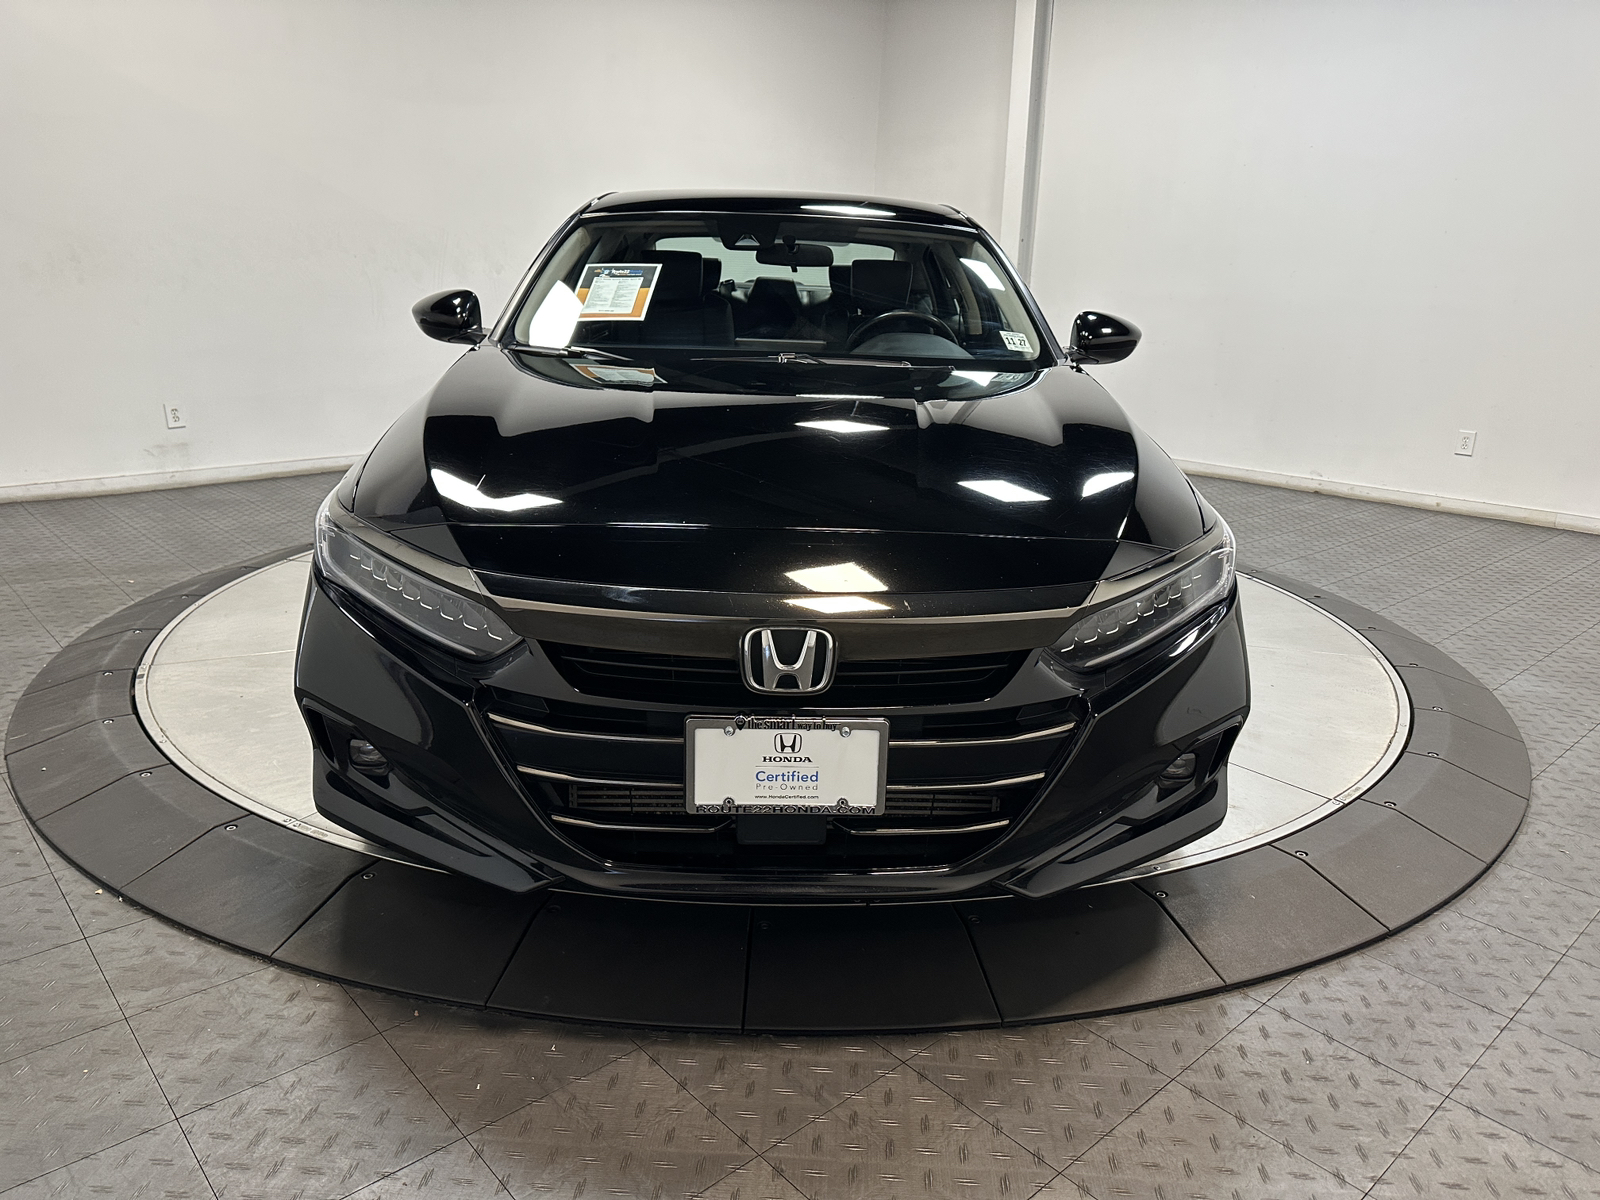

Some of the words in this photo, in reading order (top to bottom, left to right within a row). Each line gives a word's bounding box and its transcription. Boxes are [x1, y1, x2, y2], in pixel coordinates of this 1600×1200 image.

[1005, 337, 1016, 345] 11
[747, 716, 763, 730] the
[764, 716, 795, 730] smart
[797, 721, 812, 731] way
[813, 719, 821, 730] to
[822, 717, 837, 731] buy
[755, 770, 819, 782] Certified
[696, 804, 876, 814] ROUTE22HONDA.COM
